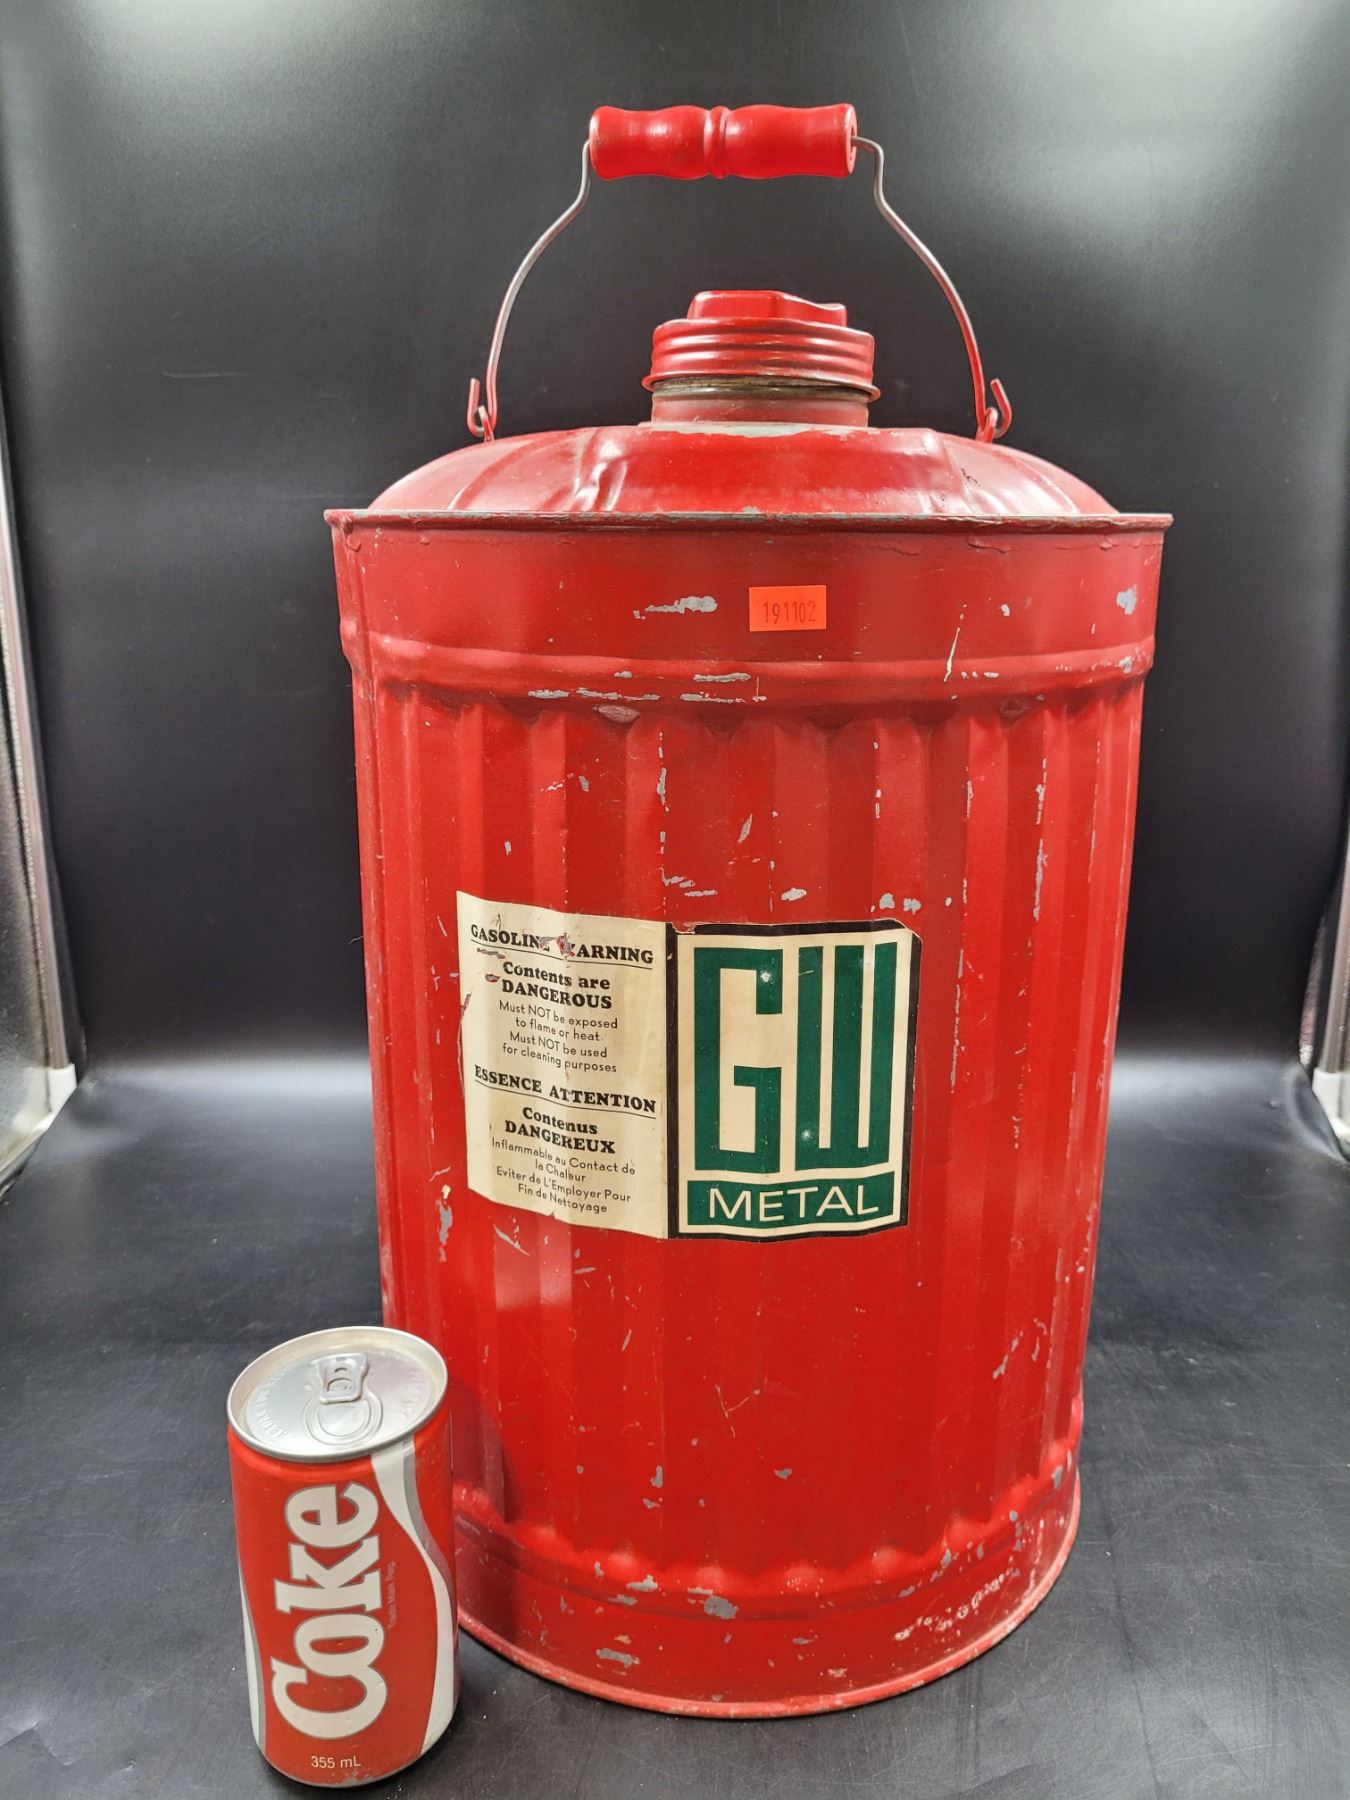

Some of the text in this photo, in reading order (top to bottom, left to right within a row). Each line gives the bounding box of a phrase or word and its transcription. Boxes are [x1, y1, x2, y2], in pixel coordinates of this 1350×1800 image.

[763, 601, 817, 625] 191102
[471, 924, 654, 965] GASOLIN ARNING
[503, 961, 610, 990] Contents are
[502, 979, 612, 1009] DANGEROUS
[499, 1000, 618, 1033] Must NOT be exposed
[515, 1016, 600, 1042] to flame or heat
[502, 1043, 617, 1074] for cleaning purposes
[509, 1031, 608, 1058] Must NOT be used
[475, 1064, 656, 1113] ESSENCE ATTENTION
[522, 1107, 598, 1135] Contenus
[505, 1120, 615, 1154] DANGEREUX
[492, 1137, 636, 1175] Inflammable au Contact de
[535, 1159, 586, 1182] la Chaleur
[496, 1166, 631, 1202] Eviter de L'Employer Pour
[518, 1183, 607, 1214] Fin de Nettoyage
[709, 1185, 879, 1222] METAL
[271, 1481, 388, 1740] Coke
[310, 1755, 362, 1769] 355 mL
